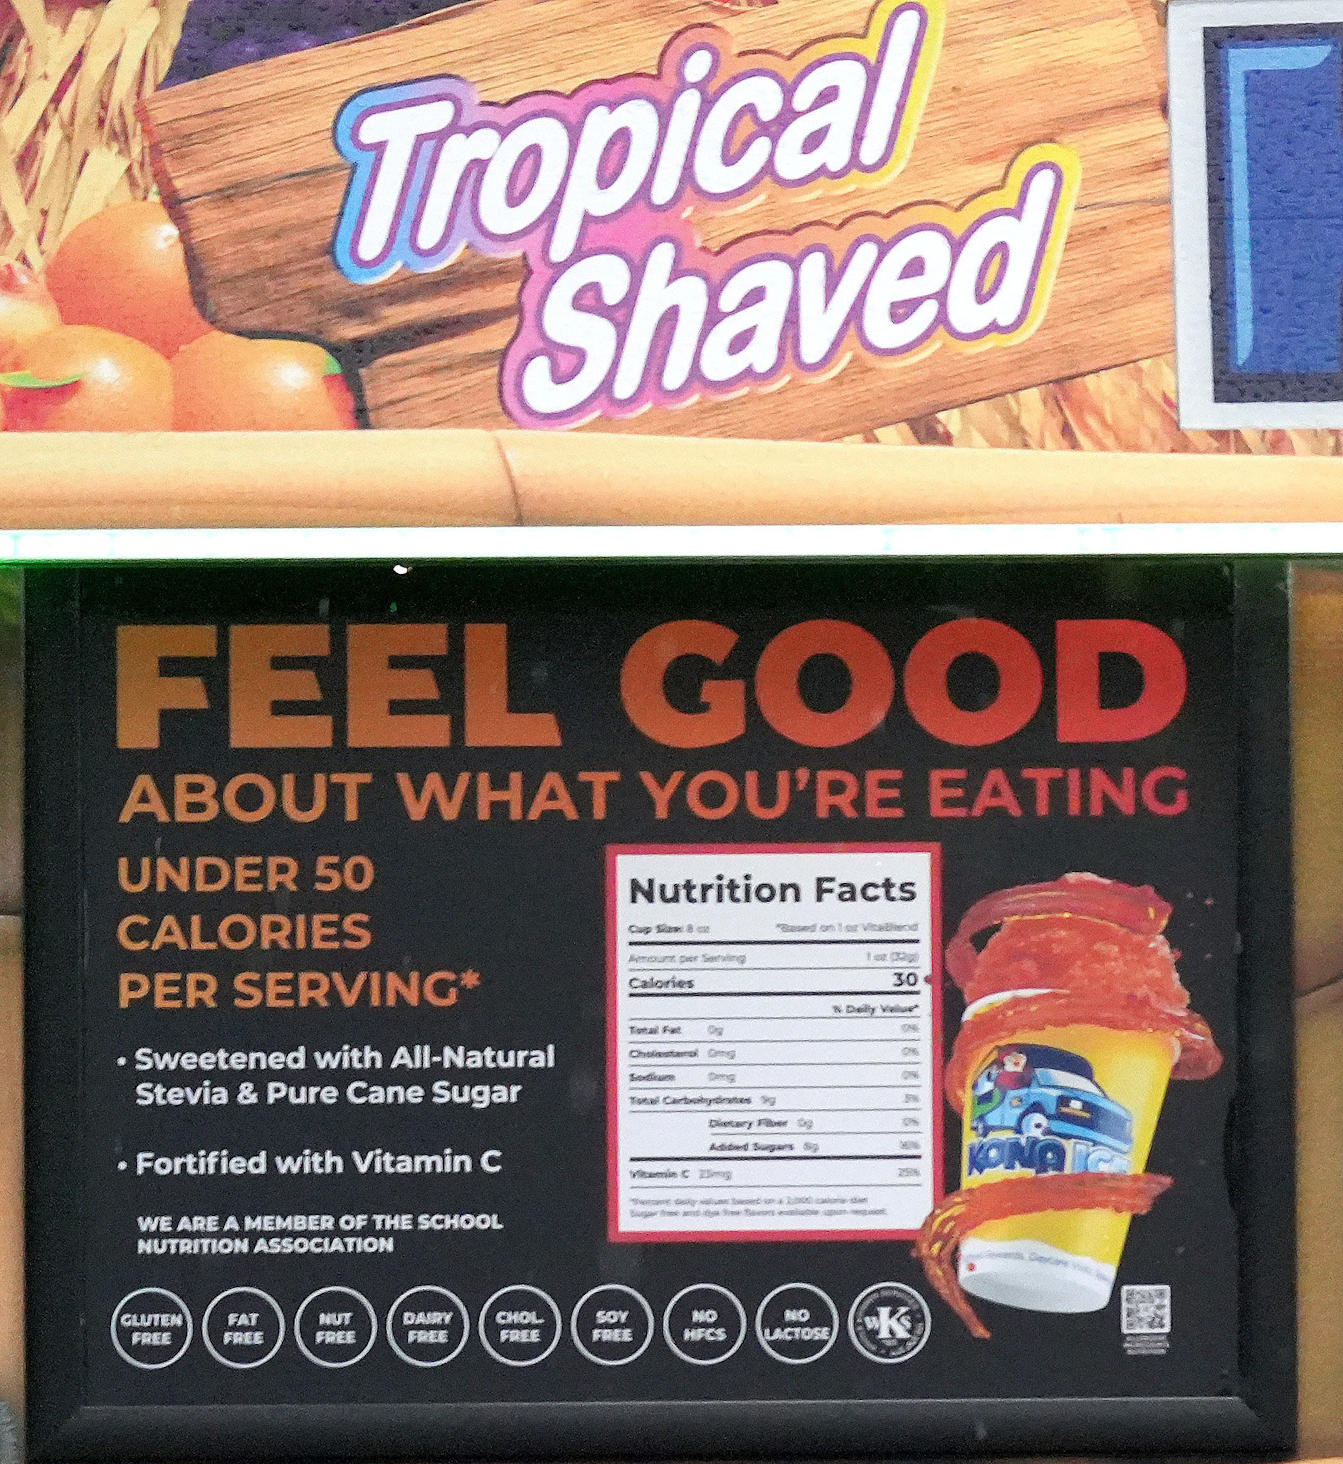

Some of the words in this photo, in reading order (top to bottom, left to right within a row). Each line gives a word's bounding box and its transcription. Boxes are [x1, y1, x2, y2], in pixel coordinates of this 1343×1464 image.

[350, 2, 928, 266] Tropical
[514, 162, 1062, 418] Shaved
[116, 623, 562, 749] FEEL
[620, 618, 1188, 748] GOOD
[118, 773, 372, 823] ABOUT
[397, 771, 621, 820] WHAT
[641, 767, 905, 820] YOU'RE
[929, 765, 1190, 818] EATING
[117, 856, 299, 892] UNDER
[314, 855, 375, 891] 50
[629, 874, 801, 904] Nutrition
[815, 876, 918, 903] Facts
[116, 914, 372, 950] CALORIES
[628, 975, 695, 989] Calories
[892, 972, 918, 987] 30
[118, 972, 218, 1009] PER
[135, 1046, 307, 1070] Sweetened
[314, 1045, 383, 1070] with
[391, 1043, 556, 1069] All-Natural
[135, 1081, 229, 1106] Stevia
[237, 1082, 258, 1105] &
[267, 1081, 339, 1104] Pure
[346, 1080, 425, 1104] Cane
[431, 1080, 522, 1109] Sugar
[136, 1151, 267, 1176] Fortified
[275, 1150, 344, 1174] with
[352, 1148, 472, 1173] Vitamin
[480, 1149, 502, 1173] C
[137, 1217, 172, 1232] WE
[177, 1216, 219, 1232] ARE
[223, 1216, 240, 1231] A
[245, 1215, 334, 1232] MEMBER
[339, 1215, 367, 1231] OF
[372, 1214, 412, 1230] THE
[417, 1213, 503, 1230] SCHOOL
[137, 1238, 249, 1255] NUTRITION
[254, 1237, 394, 1254] ASSOCIATION
[121, 1314, 183, 1328] GLUTEN
[228, 1313, 260, 1327] FAT
[319, 1313, 353, 1326] NUT
[403, 1312, 453, 1326] DAIRY
[495, 1311, 544, 1325] CHOL.
[596, 1311, 629, 1324] SOY
[692, 1310, 718, 1323] NO
[784, 1309, 811, 1323] NO
[132, 1333, 171, 1346] FREE
[223, 1332, 264, 1346] FREE
[315, 1331, 356, 1345] FREE
[407, 1330, 449, 1344] FREE
[500, 1330, 541, 1343] FREE
[592, 1329, 633, 1343] FREE
[683, 1328, 727, 1341] HFCS
[763, 1327, 831, 1341] LACTOSE
